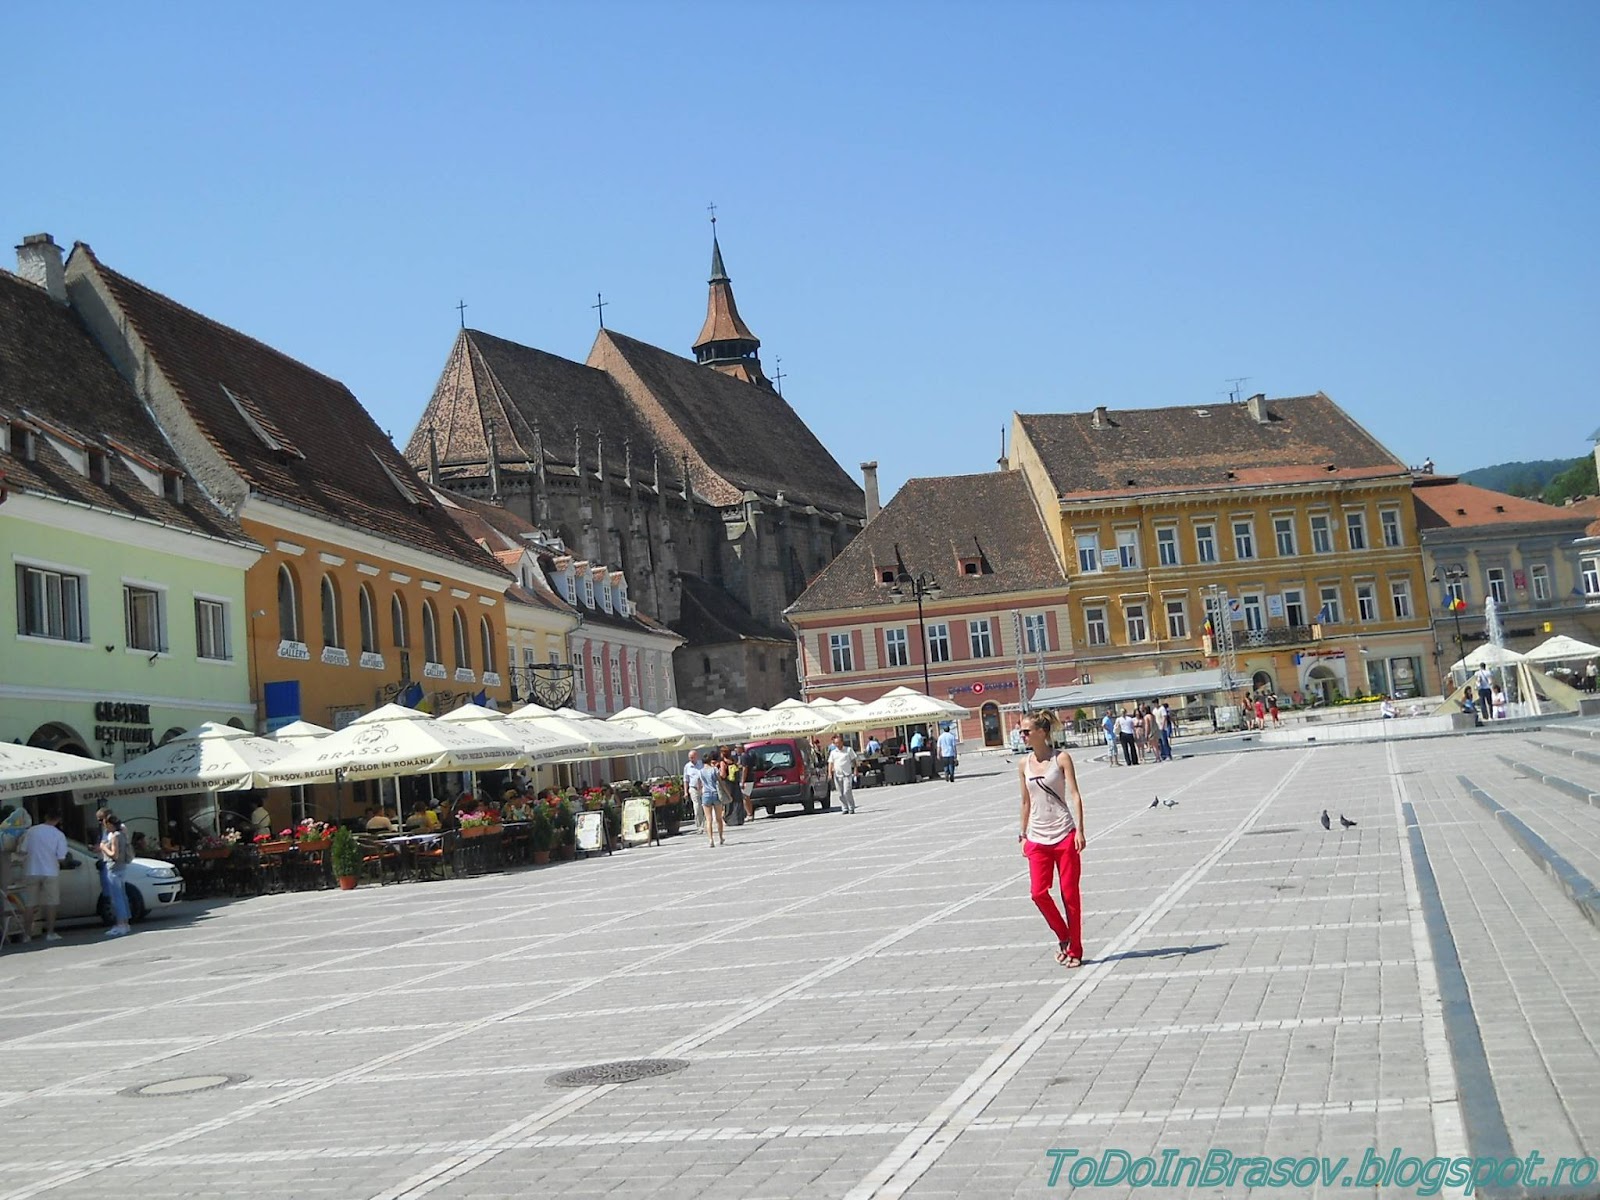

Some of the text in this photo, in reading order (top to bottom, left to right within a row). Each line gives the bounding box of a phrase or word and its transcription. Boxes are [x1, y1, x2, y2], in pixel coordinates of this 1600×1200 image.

[280, 647, 307, 659] GALLERY
[1180, 660, 1203, 671] ING
[304, 768, 334, 779] REGELE
[119, 786, 145, 797] REGELE
